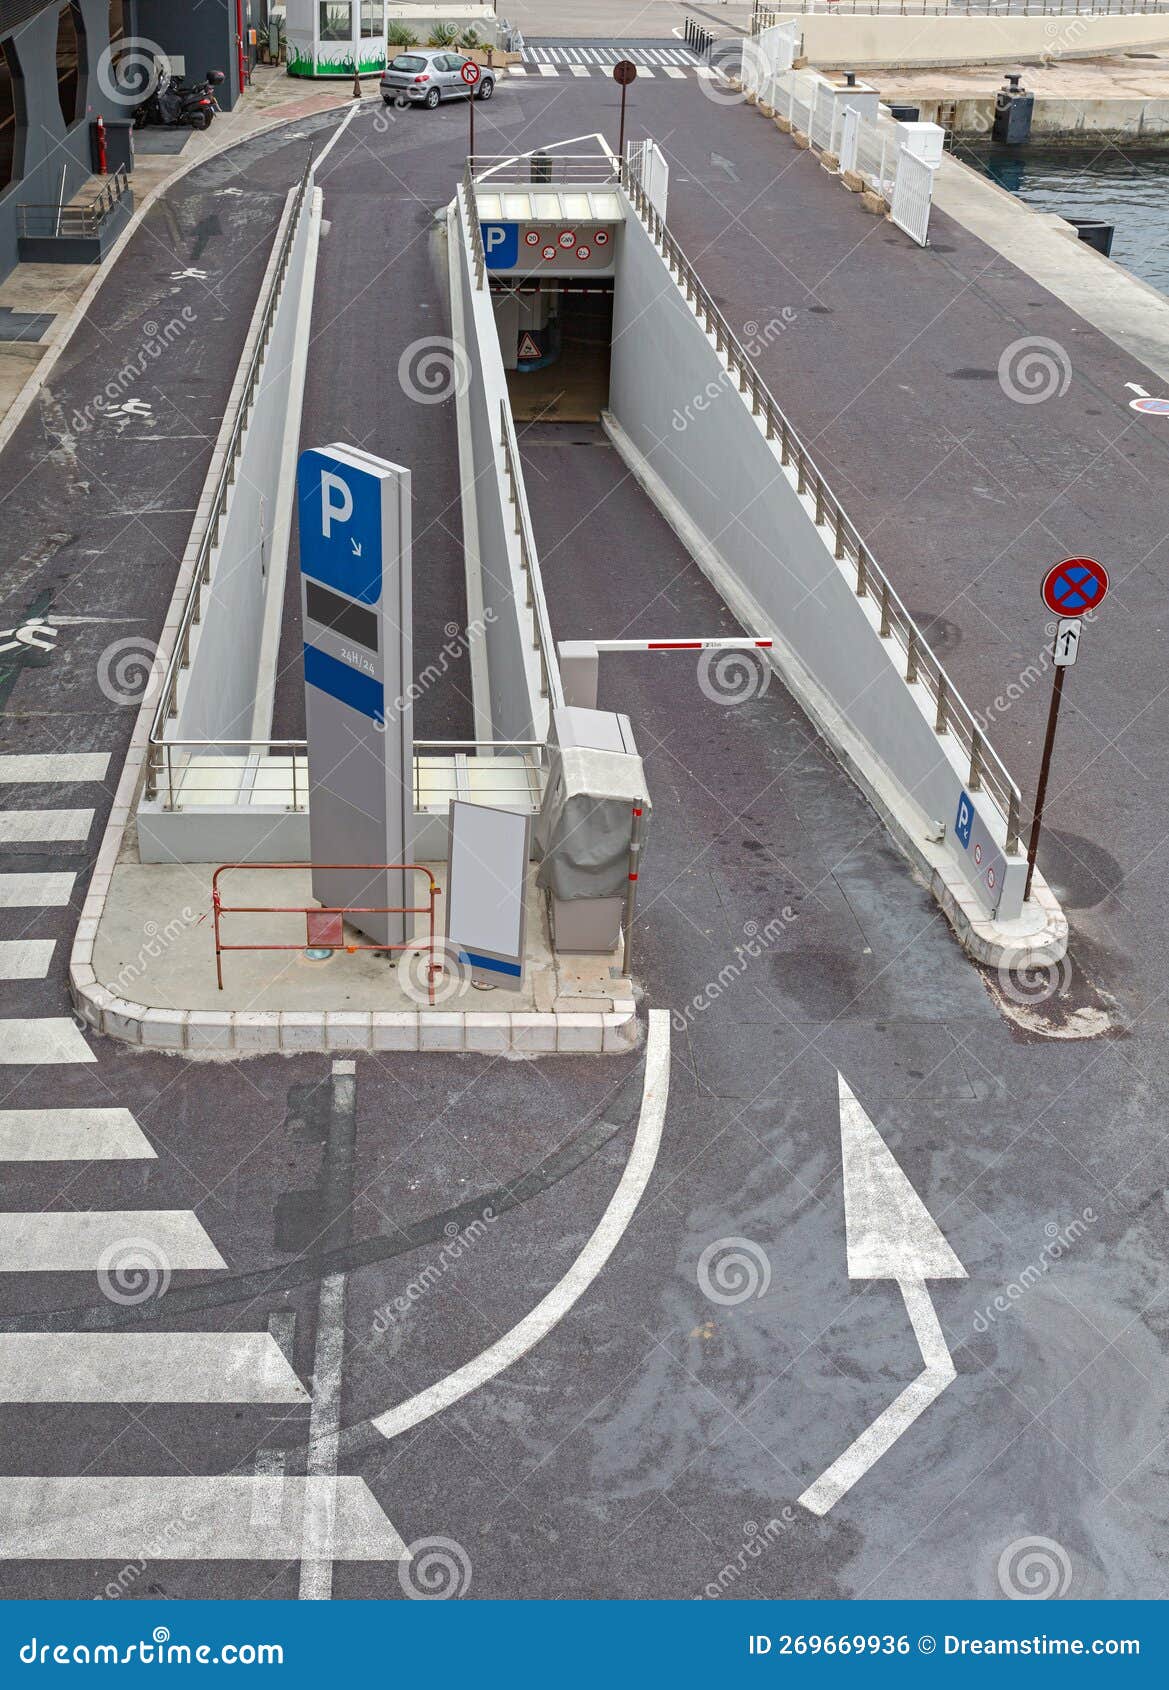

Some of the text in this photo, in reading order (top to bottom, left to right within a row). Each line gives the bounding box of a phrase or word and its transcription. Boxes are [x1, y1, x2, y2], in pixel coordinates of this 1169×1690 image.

[487, 227, 506, 252] P
[321, 469, 353, 539] P
[340, 648, 375, 675] 24H/24
[958, 801, 969, 828] P
